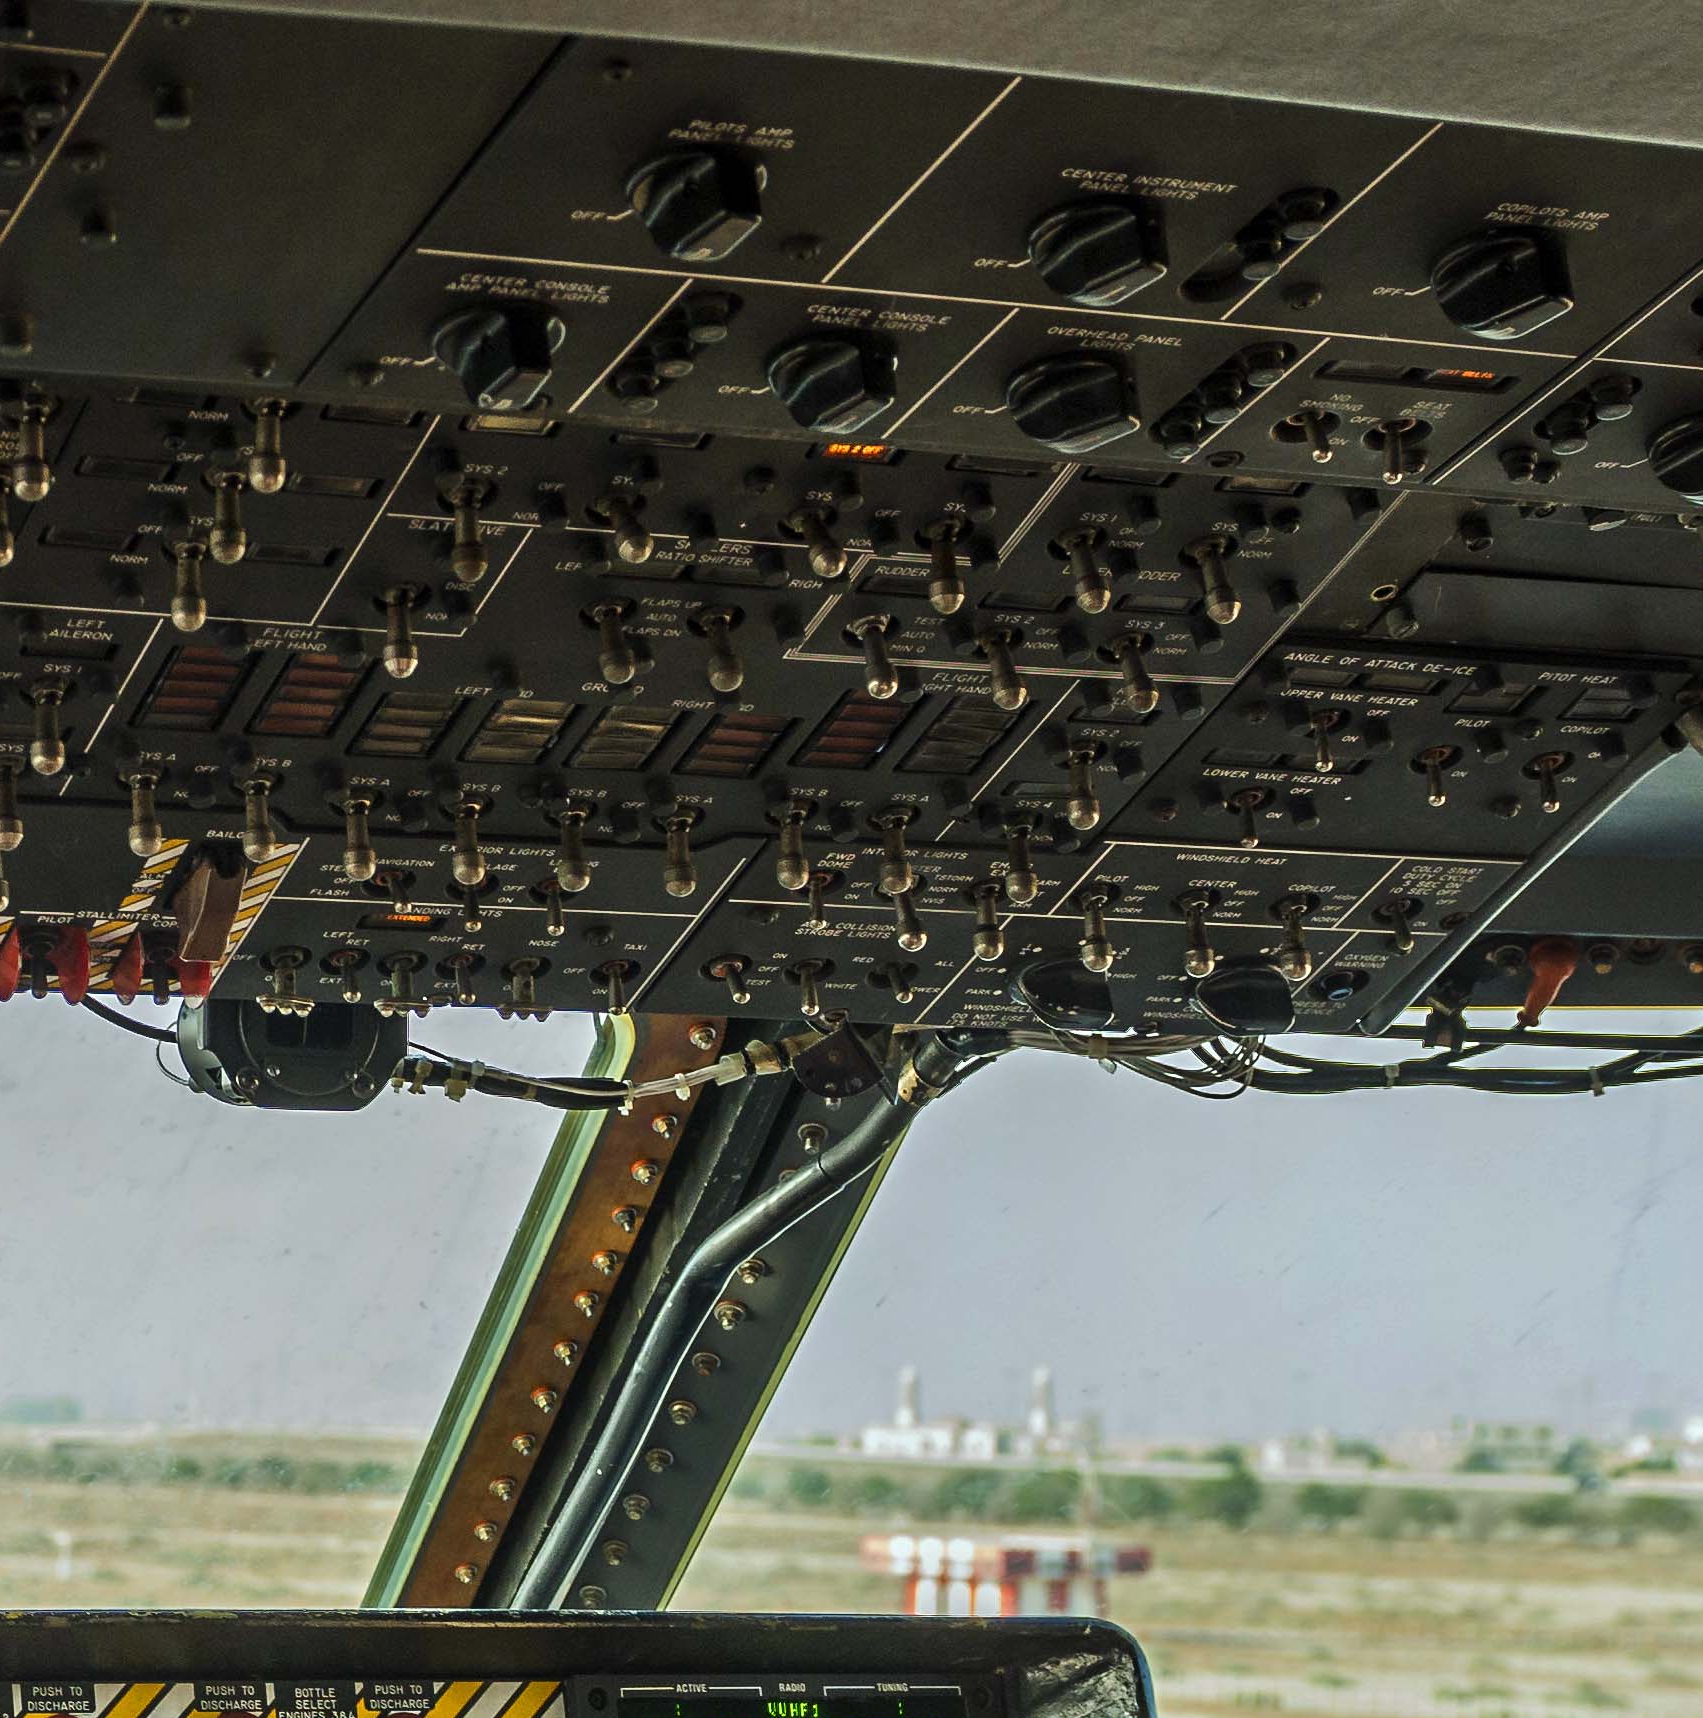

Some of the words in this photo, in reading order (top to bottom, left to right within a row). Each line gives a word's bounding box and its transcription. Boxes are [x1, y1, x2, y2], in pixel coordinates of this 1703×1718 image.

[1062, 168, 1126, 184] CENTER
[1133, 175, 1237, 193] INSTRUMENT
[1140, 188, 1198, 200] LIGHTS
[1497, 203, 1570, 217] COPILOTS
[1575, 210, 1609, 221] AMP
[1542, 218, 1600, 231] LIGHTS
[1047, 326, 1128, 341] OVERHEAD
[1133, 333, 1182, 346] PANEL
[875, 567, 930, 577] RUDDER
[66, 619, 105, 629] LEFT
[49, 629, 113, 641] AILERON
[1284, 652, 1335, 665] ANGLE
[1339, 656, 1359, 667] OF
[1365, 659, 1416, 671] ATTACK
[1422, 663, 1477, 676] DE-ICE
[1539, 672, 1578, 683] PITOT
[1583, 675, 1618, 685] HEAT
[1203, 768, 1250, 780] LOWER
[1254, 772, 1289, 783] VANE
[1293, 775, 1342, 786] HEATER
[1177, 853, 1250, 866] WINDSHIELD
[1249, 856, 1289, 867] HEAT
[36, 915, 75, 925] PILOT
[528, 939, 561, 948] NOSE
[676, 1684, 707, 1693] ACTIVE
